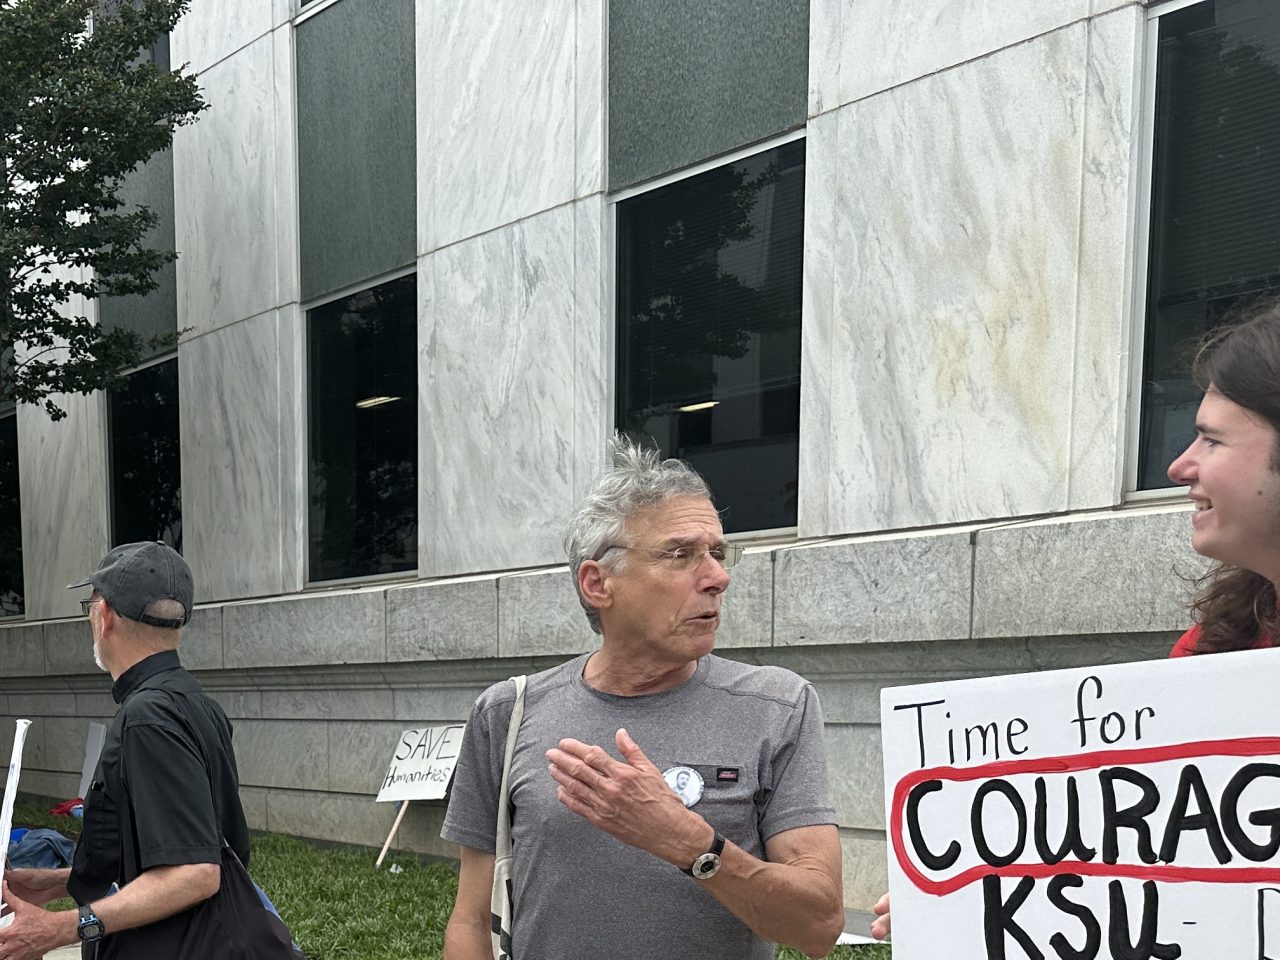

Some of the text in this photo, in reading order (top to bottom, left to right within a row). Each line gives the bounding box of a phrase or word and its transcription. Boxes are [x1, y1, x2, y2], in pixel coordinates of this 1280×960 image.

[396, 725, 464, 760] SAVE
[894, 675, 1156, 768] Time for
[382, 765, 451, 790] Humanities
[906, 763, 1280, 871] COURAG
